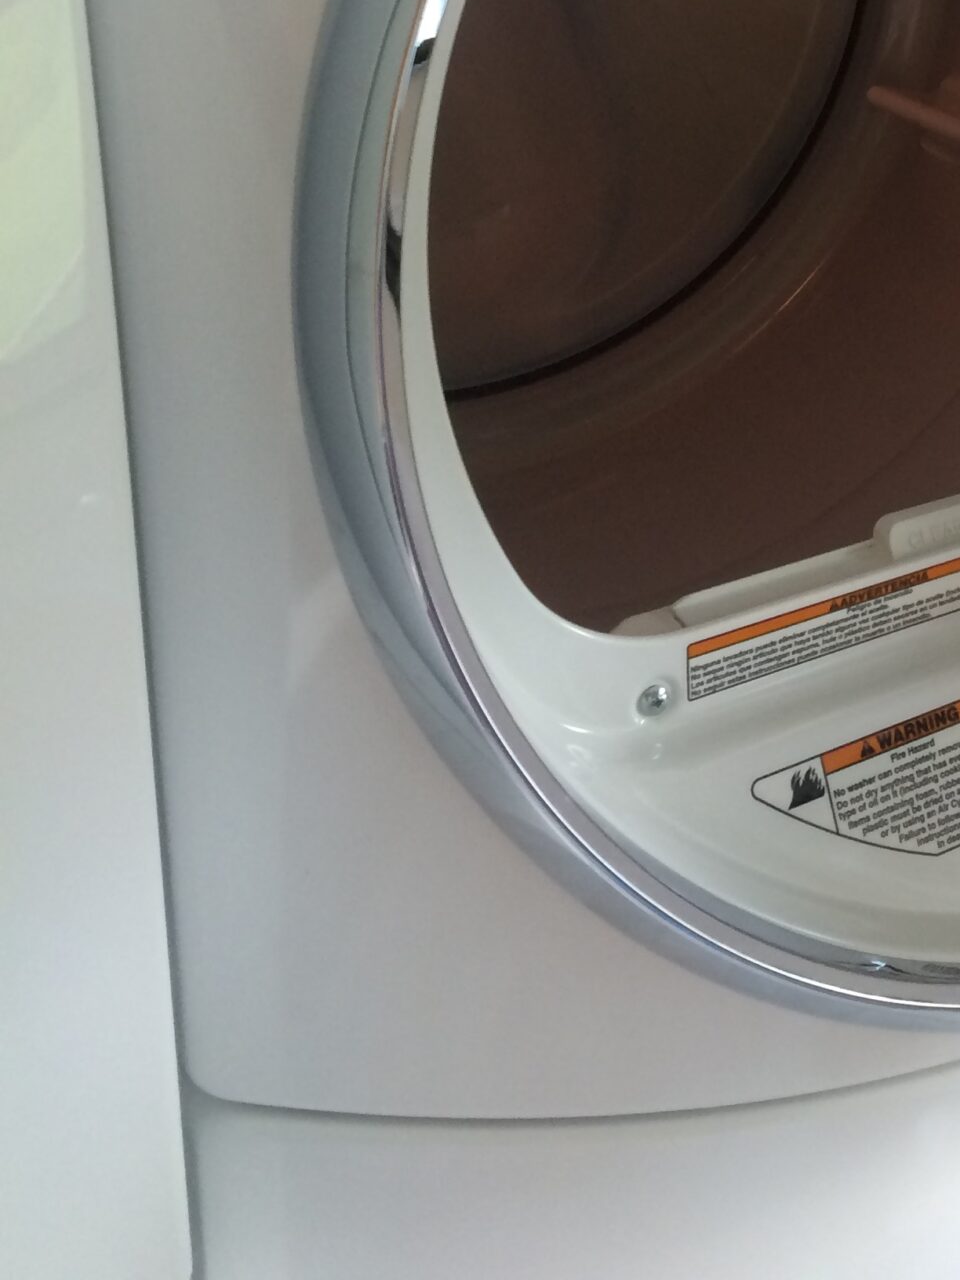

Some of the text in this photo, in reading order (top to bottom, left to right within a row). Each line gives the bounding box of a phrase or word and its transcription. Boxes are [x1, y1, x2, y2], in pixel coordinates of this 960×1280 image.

[841, 571, 928, 608] ADVERTENCIA
[876, 704, 960, 750] WARNING
[890, 738, 935, 762] Fire Hazard
[833, 788, 846, 798] No
[847, 776, 876, 792] washer
[877, 769, 893, 780] can
[894, 752, 936, 774] completely
[835, 800, 848, 810] Do
[849, 793, 864, 805] not
[864, 788, 878, 800] dry
[880, 773, 915, 792] anything
[915, 765, 932, 778] that
[932, 760, 947, 771] has
[838, 808, 857, 821] type
[857, 802, 866, 812] of
[868, 796, 879, 808] oil
[879, 793, 891, 803] on
[891, 789, 898, 798] it
[899, 774, 939, 796] (including
[847, 815, 871, 829] Items
[872, 797, 914, 819] containing
[915, 788, 938, 801] foam,
[862, 818, 889, 836] plastic
[890, 808, 910, 823] must
[911, 804, 922, 814] be
[923, 794, 944, 809] dried
[944, 790, 955, 800] on
[880, 828, 889, 838] or
[890, 823, 901, 834] by
[902, 814, 925, 828] using
[926, 809, 936, 819] an
[938, 803, 949, 814] Air
[898, 826, 926, 843] Failure
[927, 822, 936, 831] to
[937, 812, 960, 826] follow
[936, 840, 945, 848] in
